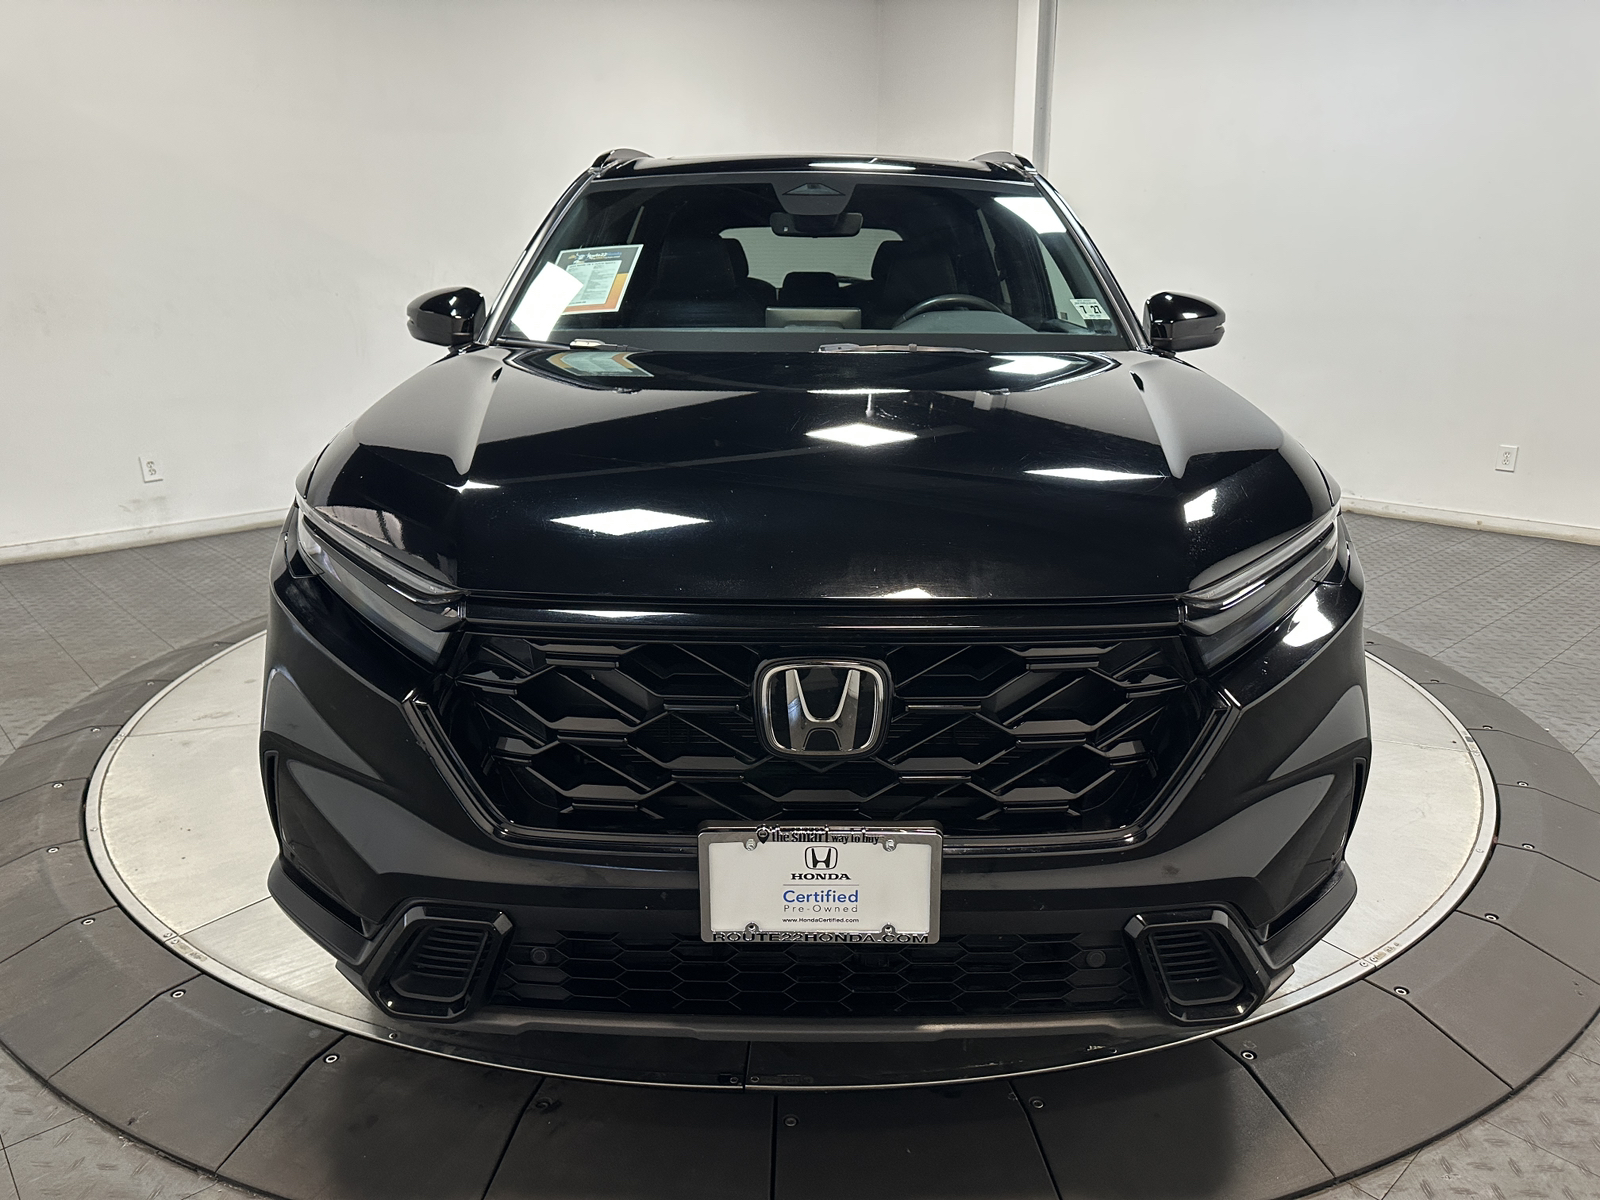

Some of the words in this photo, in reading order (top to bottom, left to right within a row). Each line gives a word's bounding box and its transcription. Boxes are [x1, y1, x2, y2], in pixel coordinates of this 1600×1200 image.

[1079, 305, 1087, 314] 7
[1090, 305, 1102, 314] 27
[771, 825, 789, 842] the
[790, 825, 830, 843] smart
[831, 834, 849, 845] way
[851, 830, 861, 843] to
[862, 829, 880, 845] buy
[790, 873, 851, 881] HONDA
[782, 889, 859, 903] Certified
[783, 904, 858, 913] Pre-Owned
[712, 931, 929, 944] ROUTE22HONDA.COM
